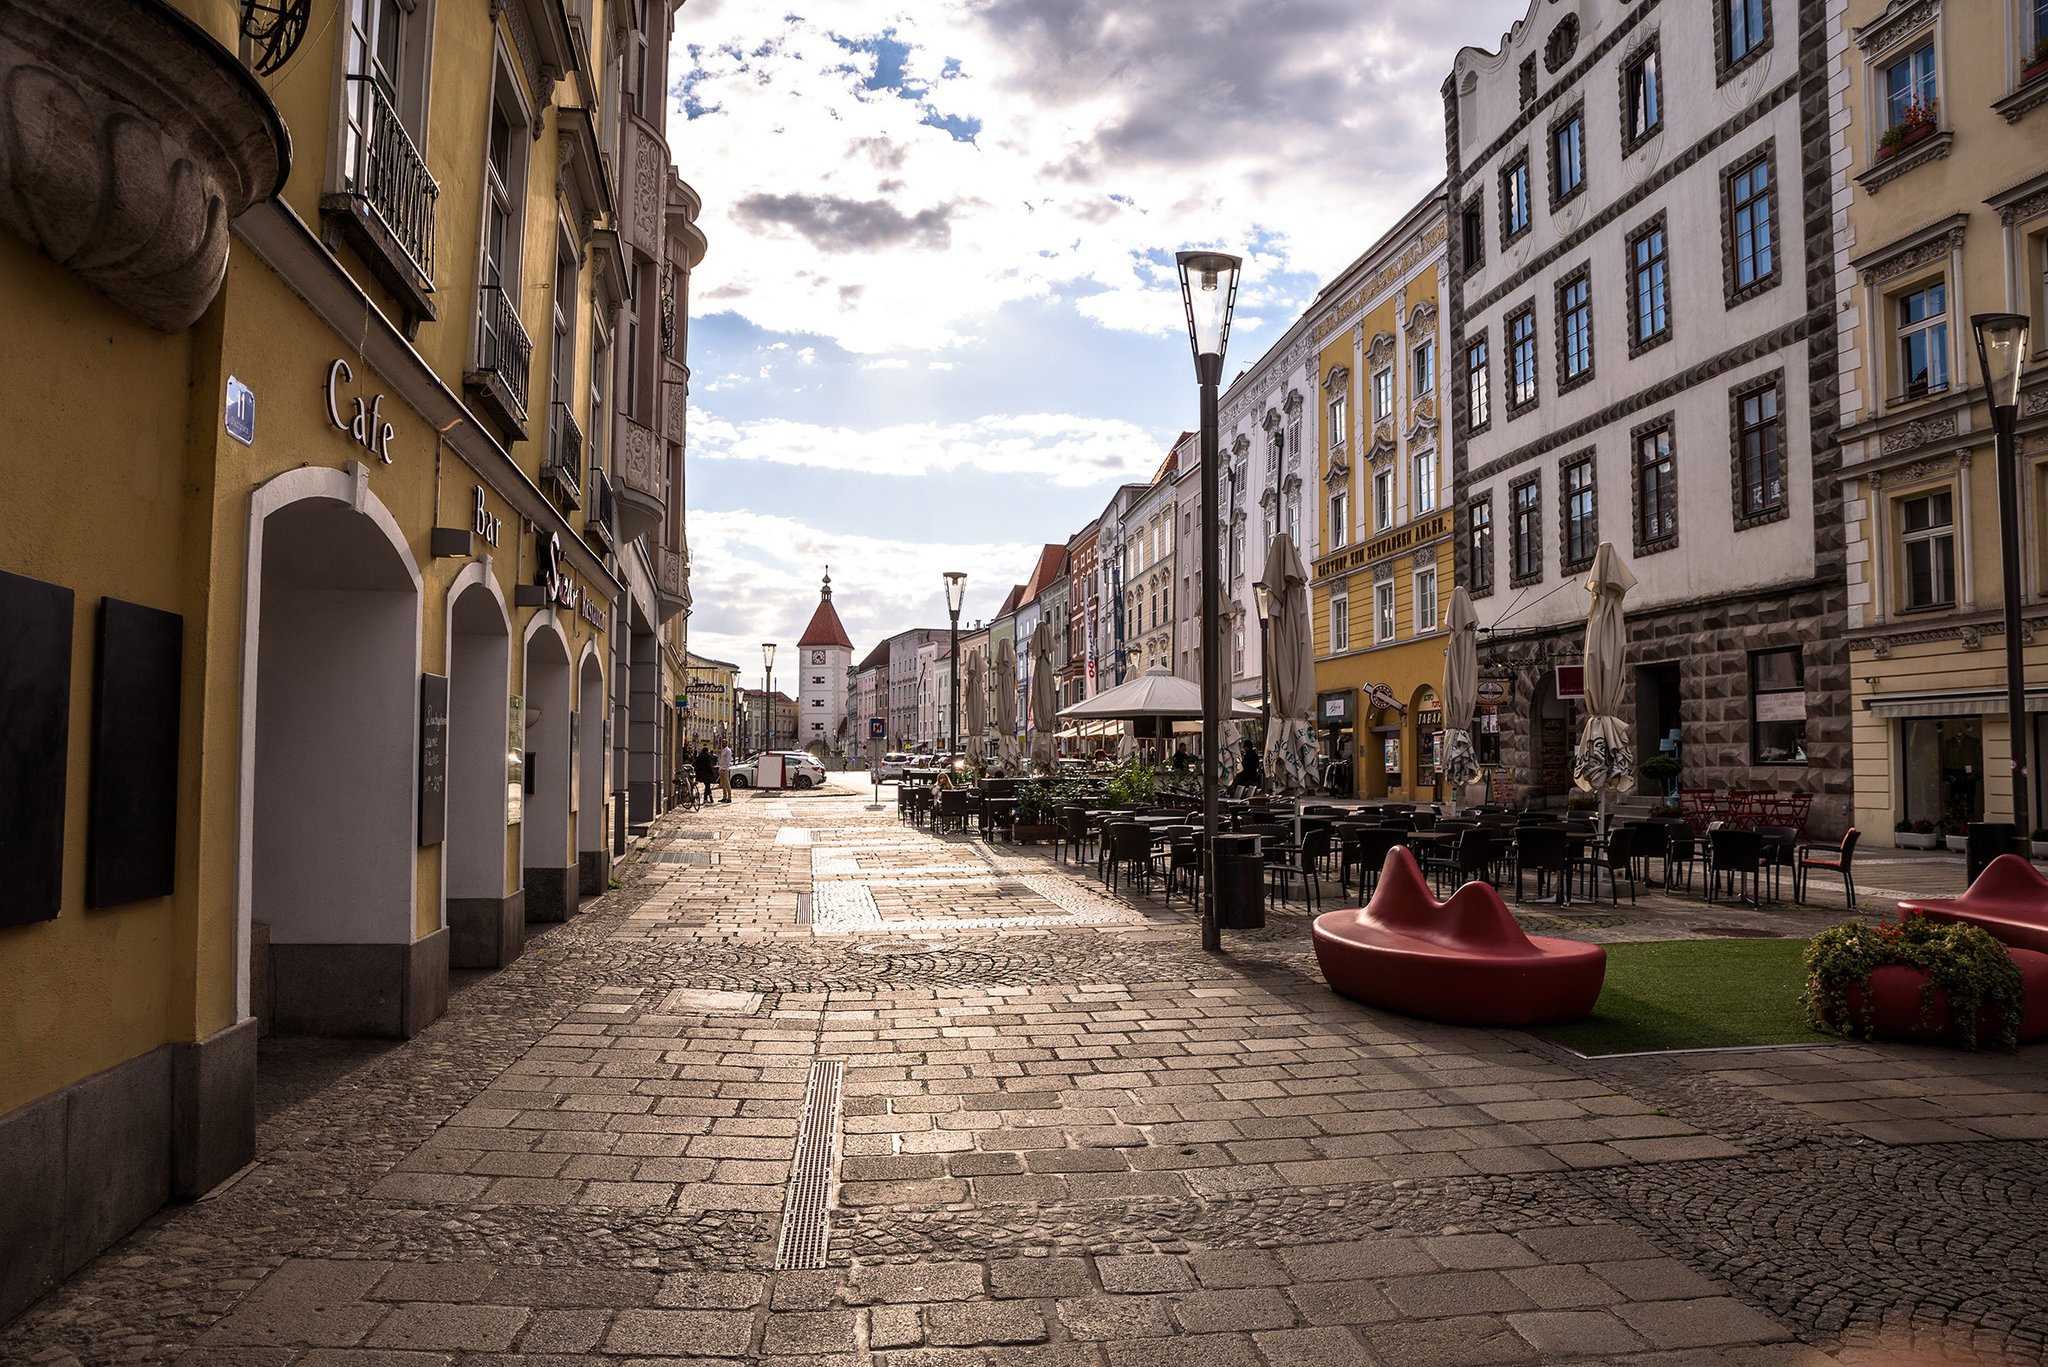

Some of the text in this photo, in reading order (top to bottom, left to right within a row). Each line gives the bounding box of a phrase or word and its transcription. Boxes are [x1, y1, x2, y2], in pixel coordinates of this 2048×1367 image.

[237, 390, 246, 421] 11
[325, 359, 394, 465] Cafe
[474, 484, 501, 548] Bar
[1318, 555, 1348, 577] GASTHOF
[1350, 548, 1365, 567] ZUM
[1367, 530, 1412, 560] SCHWARZEN
[686, 684, 724, 692] makka
[1418, 713, 1442, 725] TABAK
